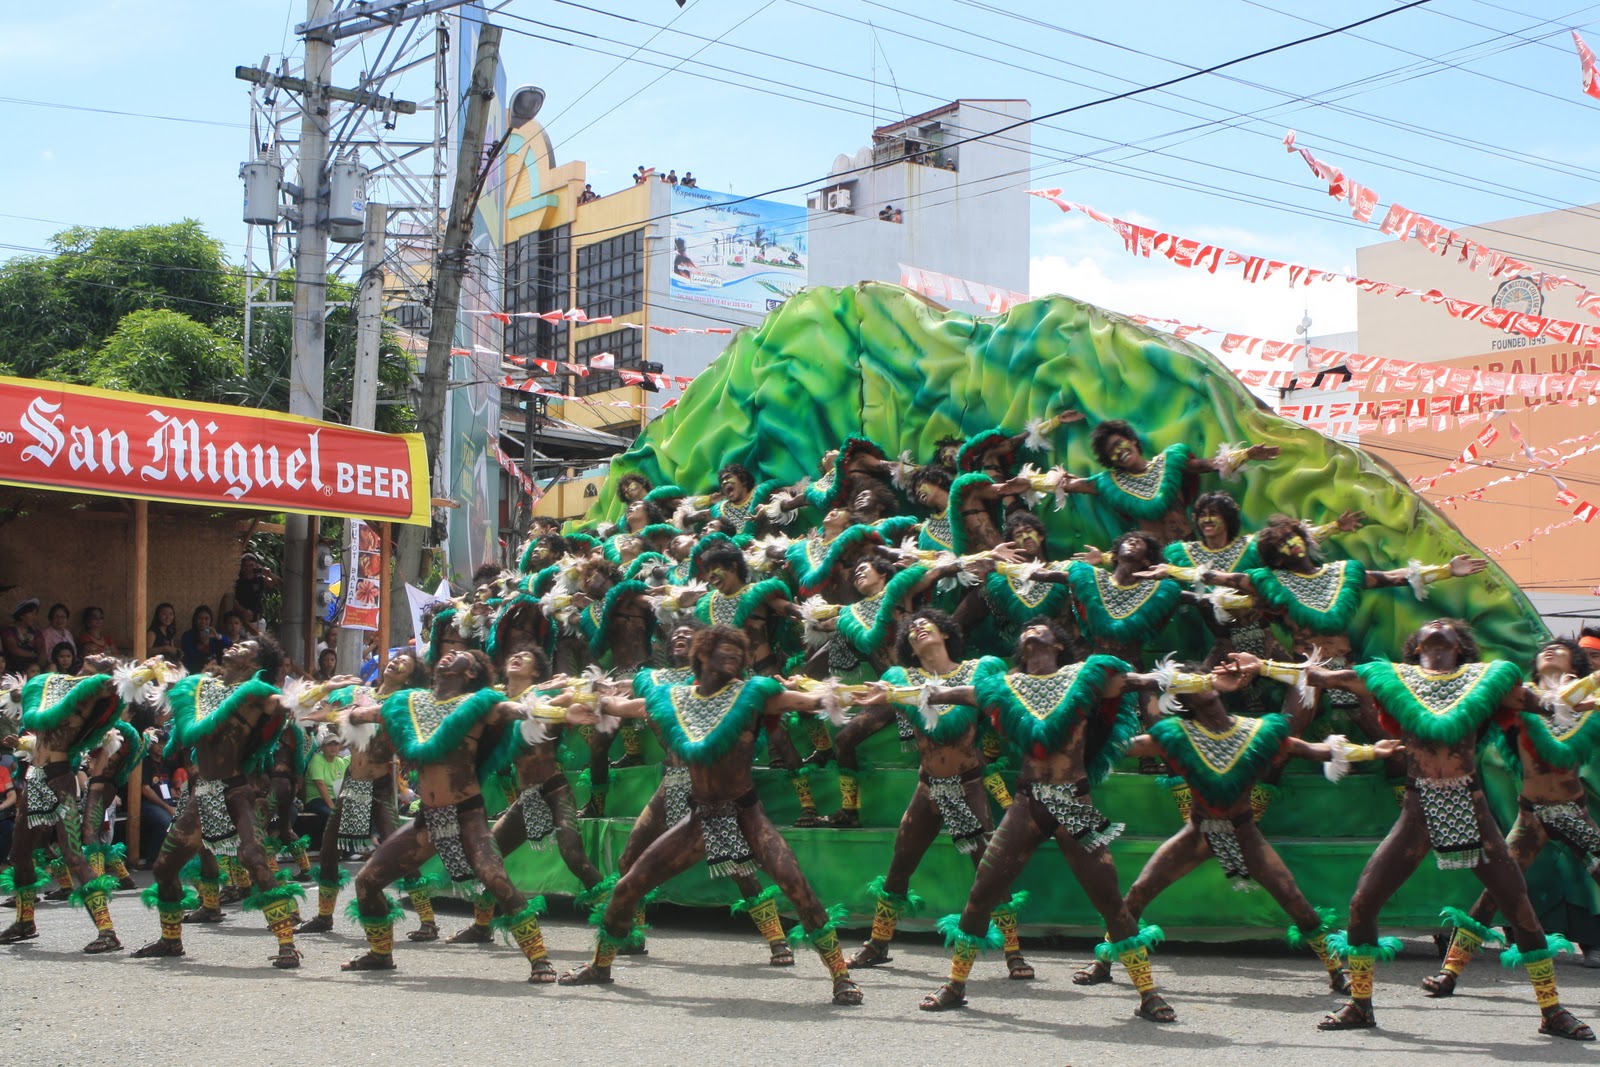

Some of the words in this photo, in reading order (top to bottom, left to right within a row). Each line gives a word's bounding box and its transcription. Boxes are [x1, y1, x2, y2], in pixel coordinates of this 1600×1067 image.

[1491, 337, 1526, 350] FOUNDED
[20, 396, 134, 477] San
[140, 409, 324, 500] Miguel
[336, 461, 410, 501] BEER
[347, 568, 357, 604] BALAT
